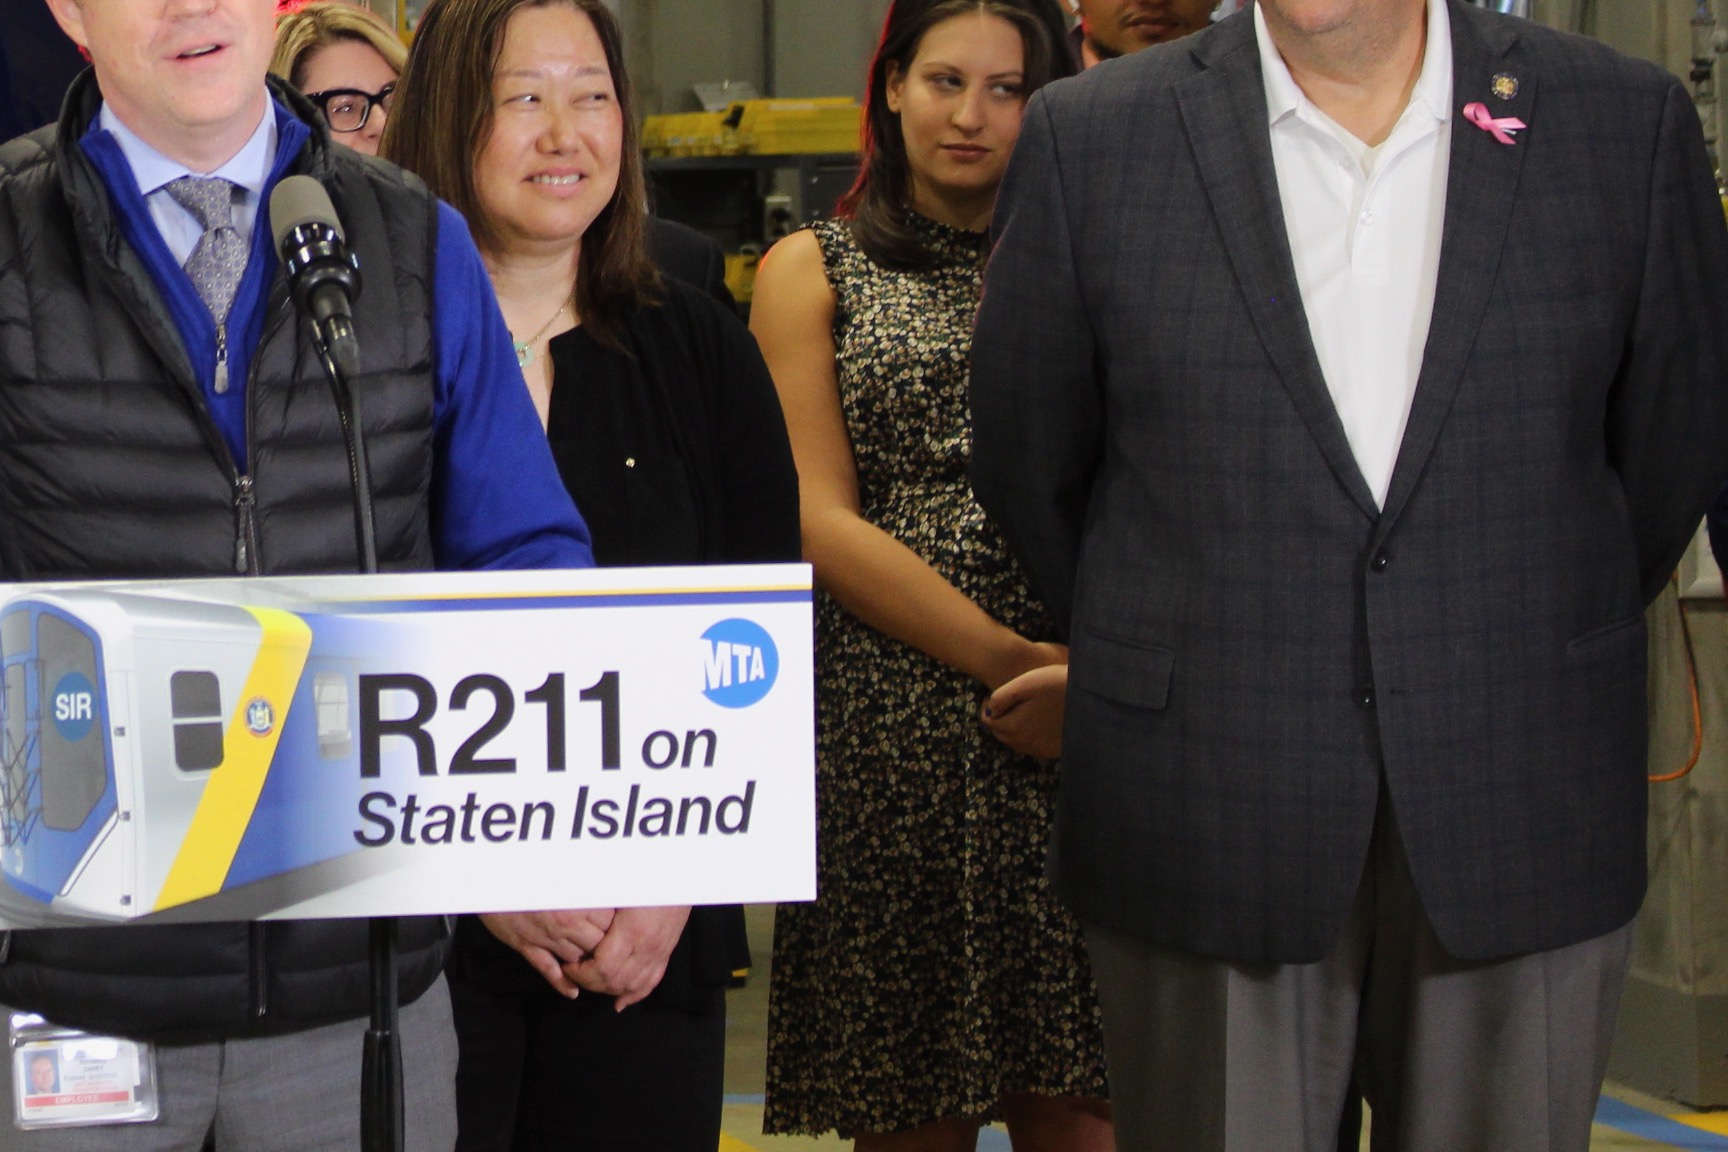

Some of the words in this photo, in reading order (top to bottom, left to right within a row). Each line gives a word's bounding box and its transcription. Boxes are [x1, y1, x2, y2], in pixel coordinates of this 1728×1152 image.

[55, 692, 92, 722] SIR
[358, 670, 621, 779] R211
[641, 727, 718, 771] on
[353, 790, 556, 848] Staten
[570, 780, 757, 841] Island
